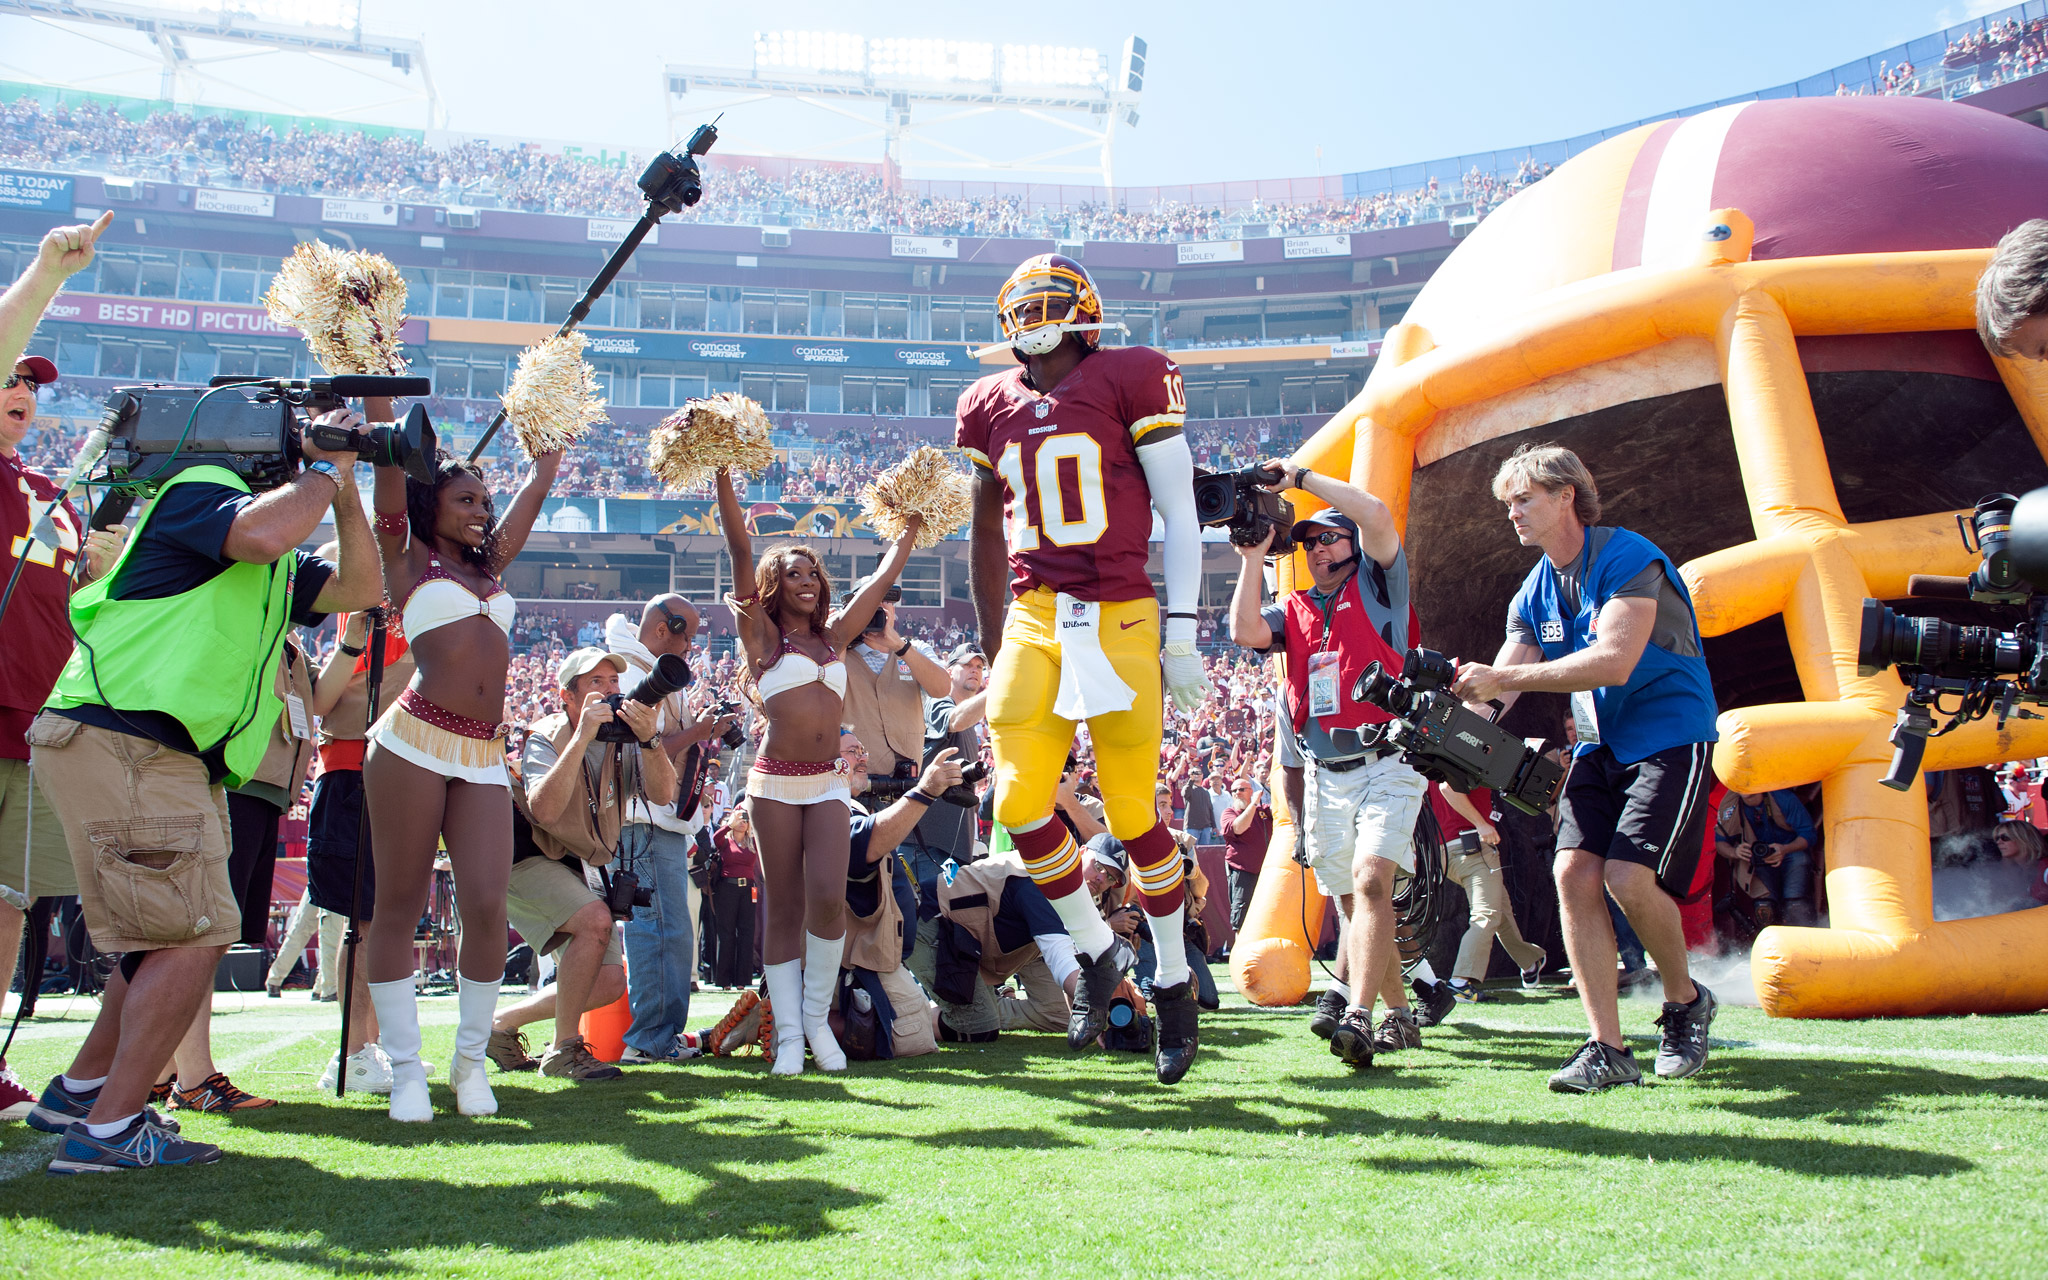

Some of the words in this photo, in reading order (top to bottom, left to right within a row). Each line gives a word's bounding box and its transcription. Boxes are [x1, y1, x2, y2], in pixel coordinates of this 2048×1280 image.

[16, 175, 68, 191] TODAY
[200, 191, 218, 200] Phil
[199, 202, 259, 214] HOCHBERG
[326, 202, 347, 210] Cliff
[325, 211, 369, 221] BATTLES
[590, 222, 615, 231] Larry
[590, 231, 626, 240] BROWN
[894, 239, 913, 247] Billy
[1286, 240, 1310, 248] Brian
[894, 247, 928, 255] KILMER
[1287, 246, 1331, 256] MITCHELL
[1180, 253, 1216, 262] DUDLEY
[98, 303, 153, 323] BEST
[160, 308, 191, 327] HD
[586, 337, 635, 348] comcast
[692, 342, 741, 352] comcast
[593, 345, 642, 354] SPORTSNET
[699, 350, 747, 358] SPORTSNET
[796, 347, 845, 357] comcast
[803, 354, 850, 363] SPORTSNET
[898, 350, 946, 360] comcast
[905, 358, 952, 366] SPORTSNET
[1162, 374, 1187, 414] 10
[1028, 424, 1058, 436] REDSKINS
[319, 431, 347, 442] Canon
[998, 431, 1109, 553] 10
[1062, 620, 1091, 629] Wilson
[1541, 624, 1562, 639] SDS
[1455, 730, 1480, 748] ARRI
[693, 780, 704, 796] EOS
[287, 805, 308, 822] 89
